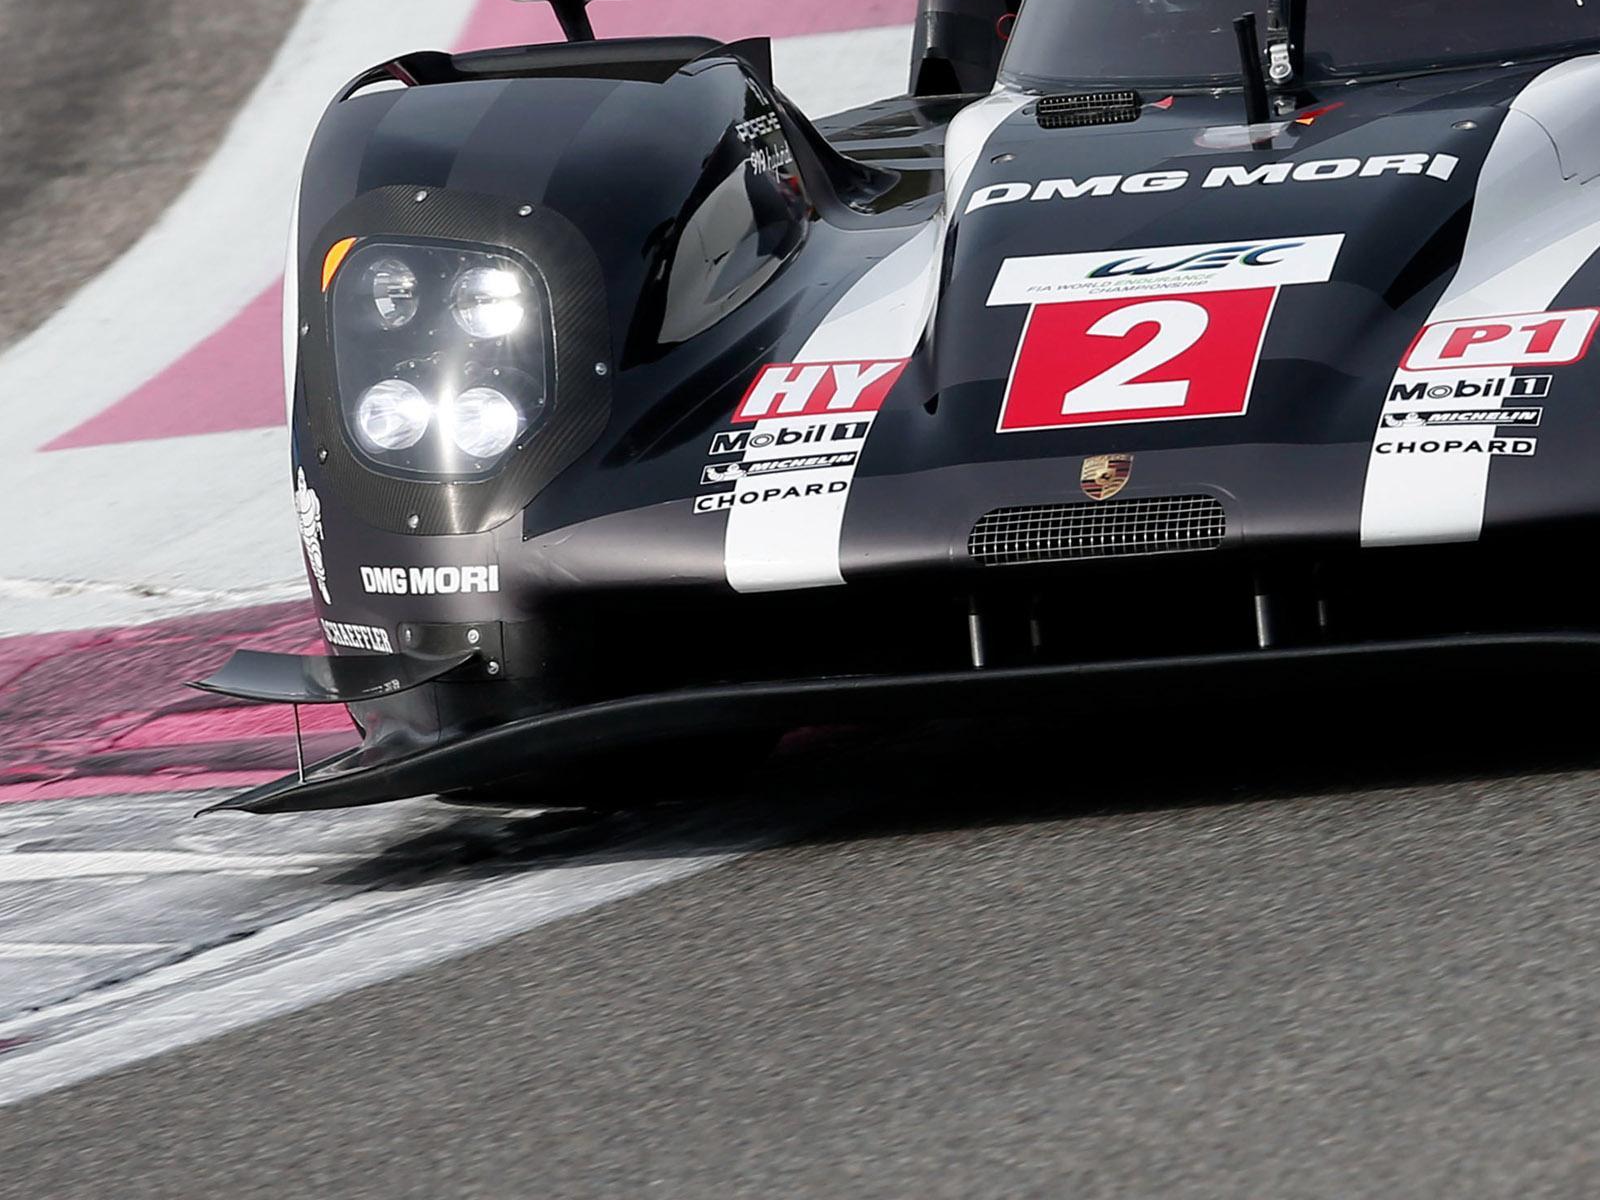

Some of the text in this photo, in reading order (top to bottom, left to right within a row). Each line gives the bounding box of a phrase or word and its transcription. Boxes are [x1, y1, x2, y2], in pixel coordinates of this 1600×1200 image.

[965, 153, 1459, 214] DMG MORI
[1085, 242, 1306, 279] WEC
[1027, 273, 1218, 292] FIA WORLD ENDURANCE
[1088, 280, 1209, 294] CHAMPIONSHIP
[1438, 318, 1567, 360] P1
[1061, 300, 1209, 415] 2
[739, 362, 903, 417] HY
[1389, 377, 1506, 401] Mobil
[1427, 411, 1538, 423] MICHELIN
[711, 424, 826, 454] Mobil
[1375, 439, 1533, 454] CHOPARD
[748, 453, 856, 472] MICHELIN
[697, 481, 848, 511] CHOPARD
[360, 564, 500, 595] DMG MORI
[320, 617, 394, 654] SCHAEFFLER
